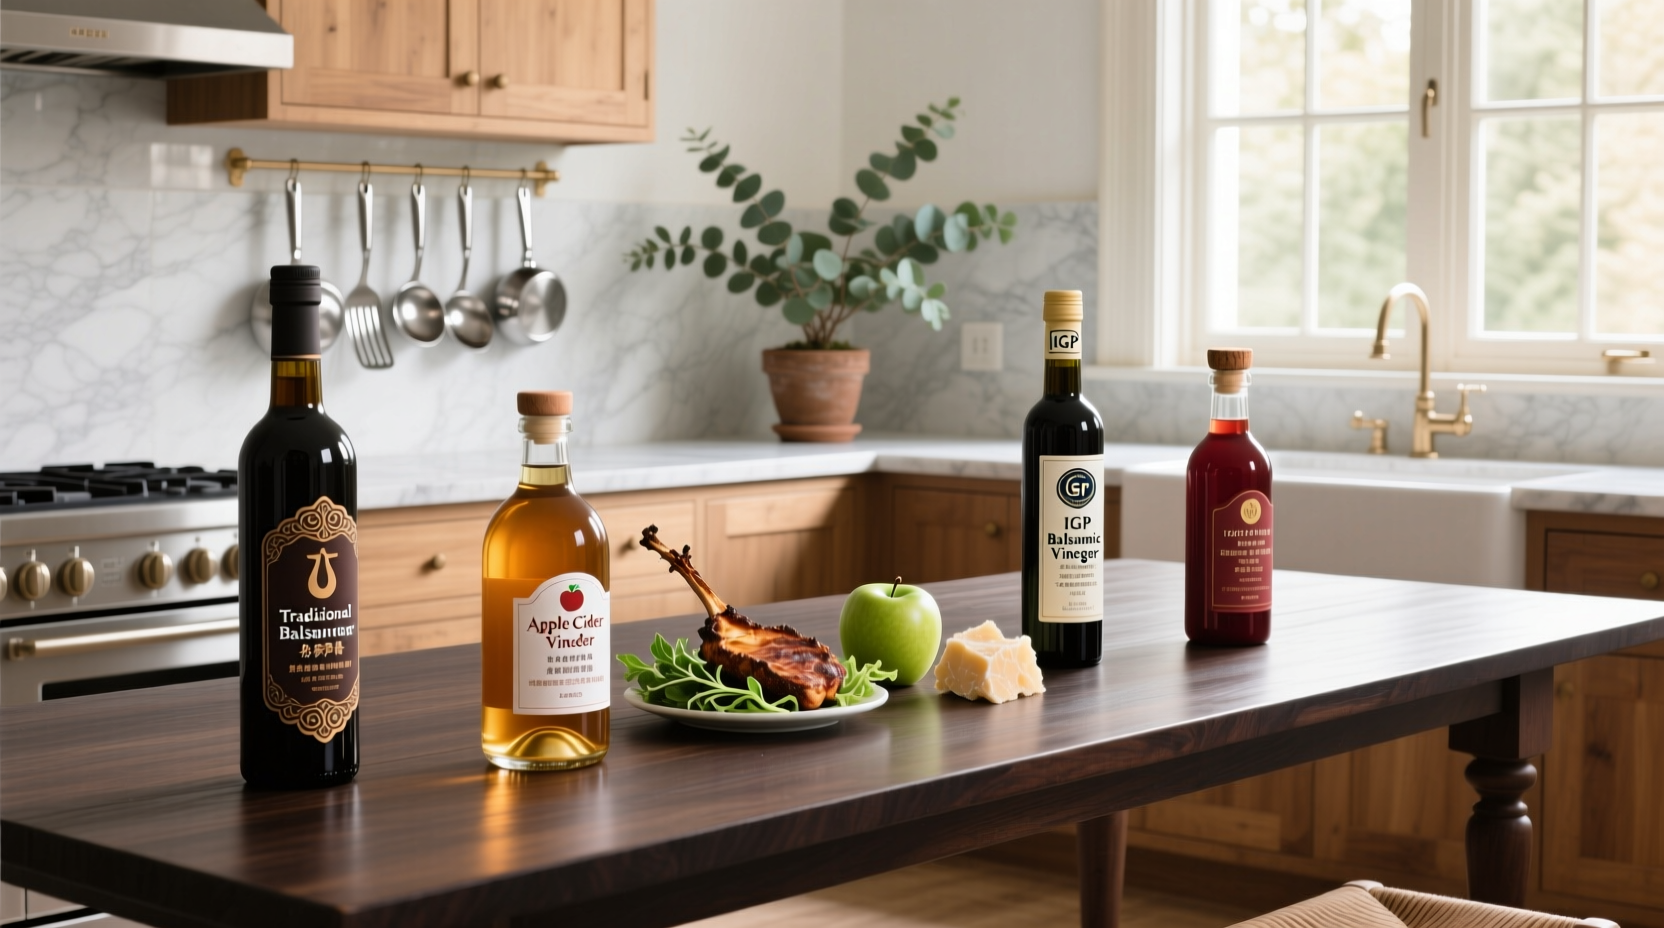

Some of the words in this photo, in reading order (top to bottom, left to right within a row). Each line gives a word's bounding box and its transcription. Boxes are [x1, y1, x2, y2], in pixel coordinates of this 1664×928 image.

[1054, 335, 1079, 349] IGP
[1064, 516, 1092, 530] IGP
[526, 616, 570, 635] Apple
[572, 614, 605, 630] Cider
